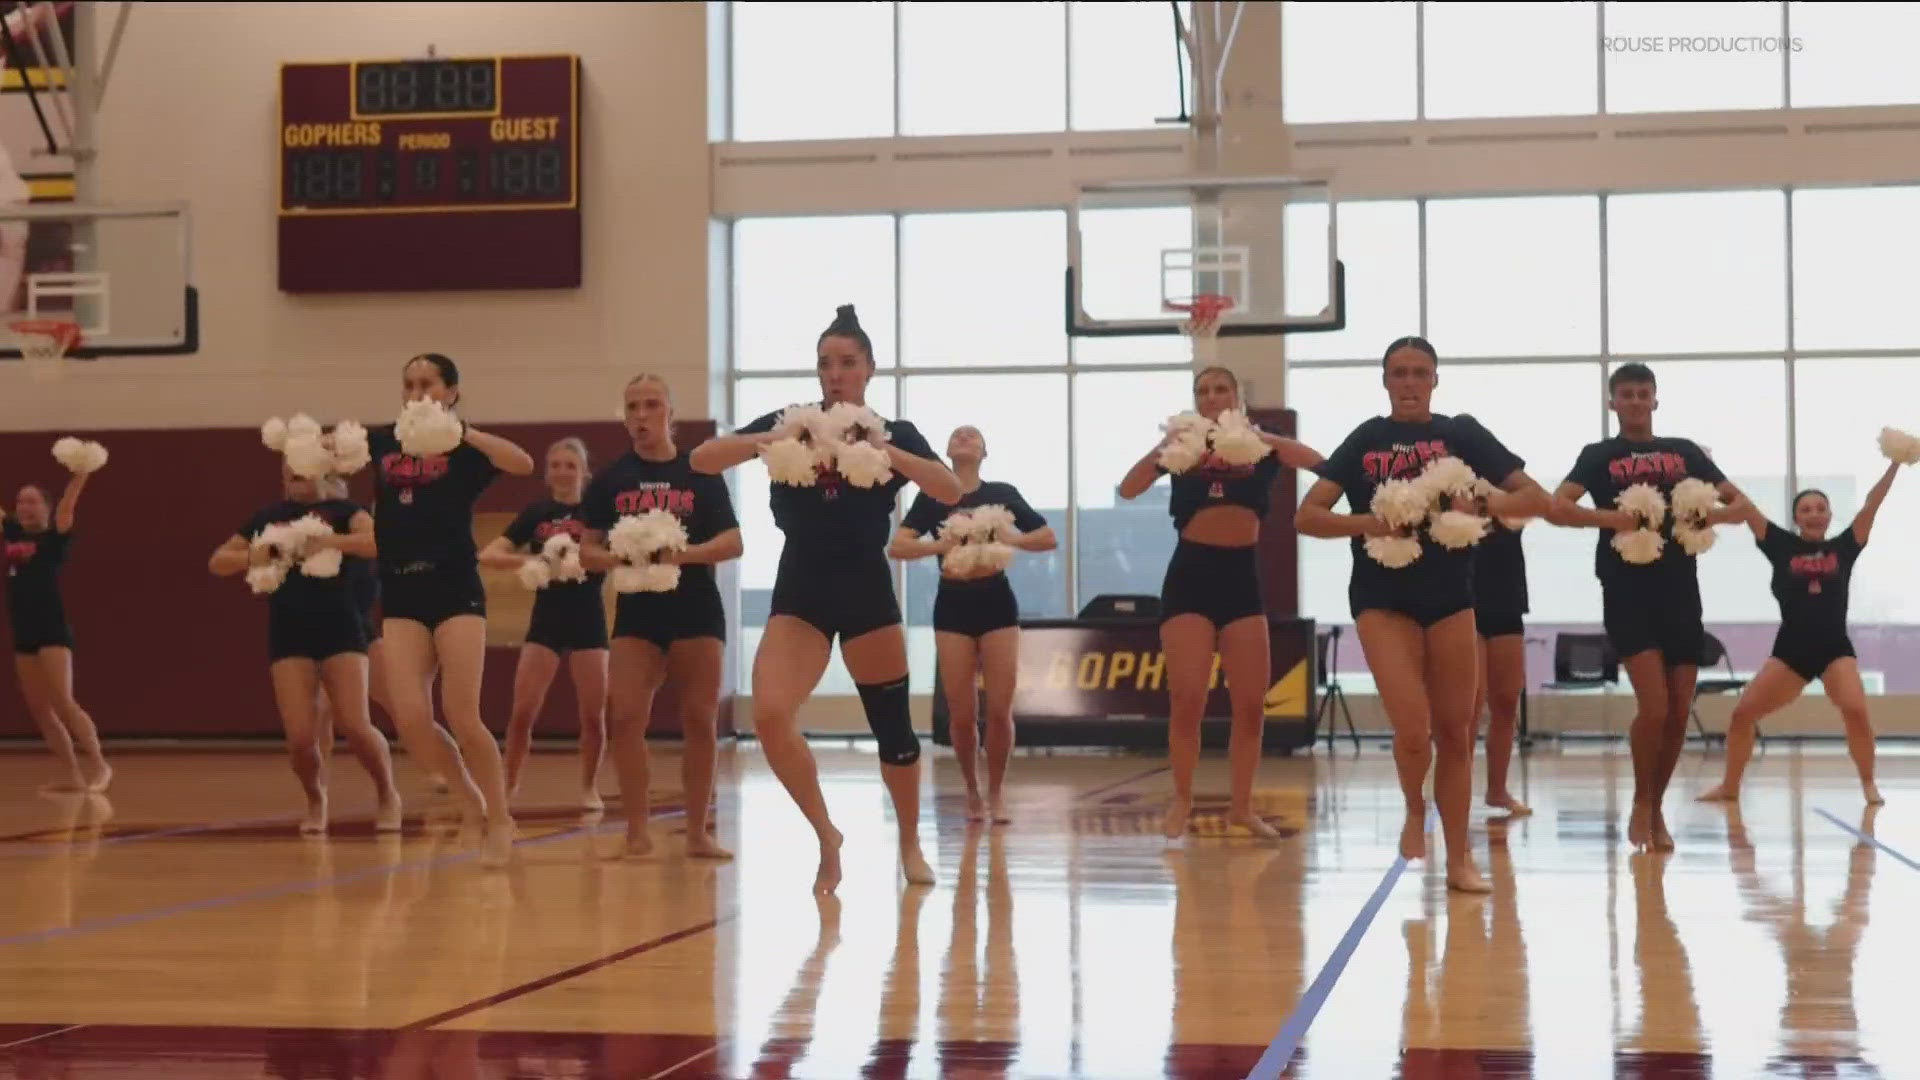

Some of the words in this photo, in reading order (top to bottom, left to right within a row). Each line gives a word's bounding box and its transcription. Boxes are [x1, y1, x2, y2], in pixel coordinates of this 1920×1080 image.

[284, 122, 382, 147] GOPHERS
[489, 116, 560, 142] GUEST
[1049, 651, 1230, 691] GOPH
